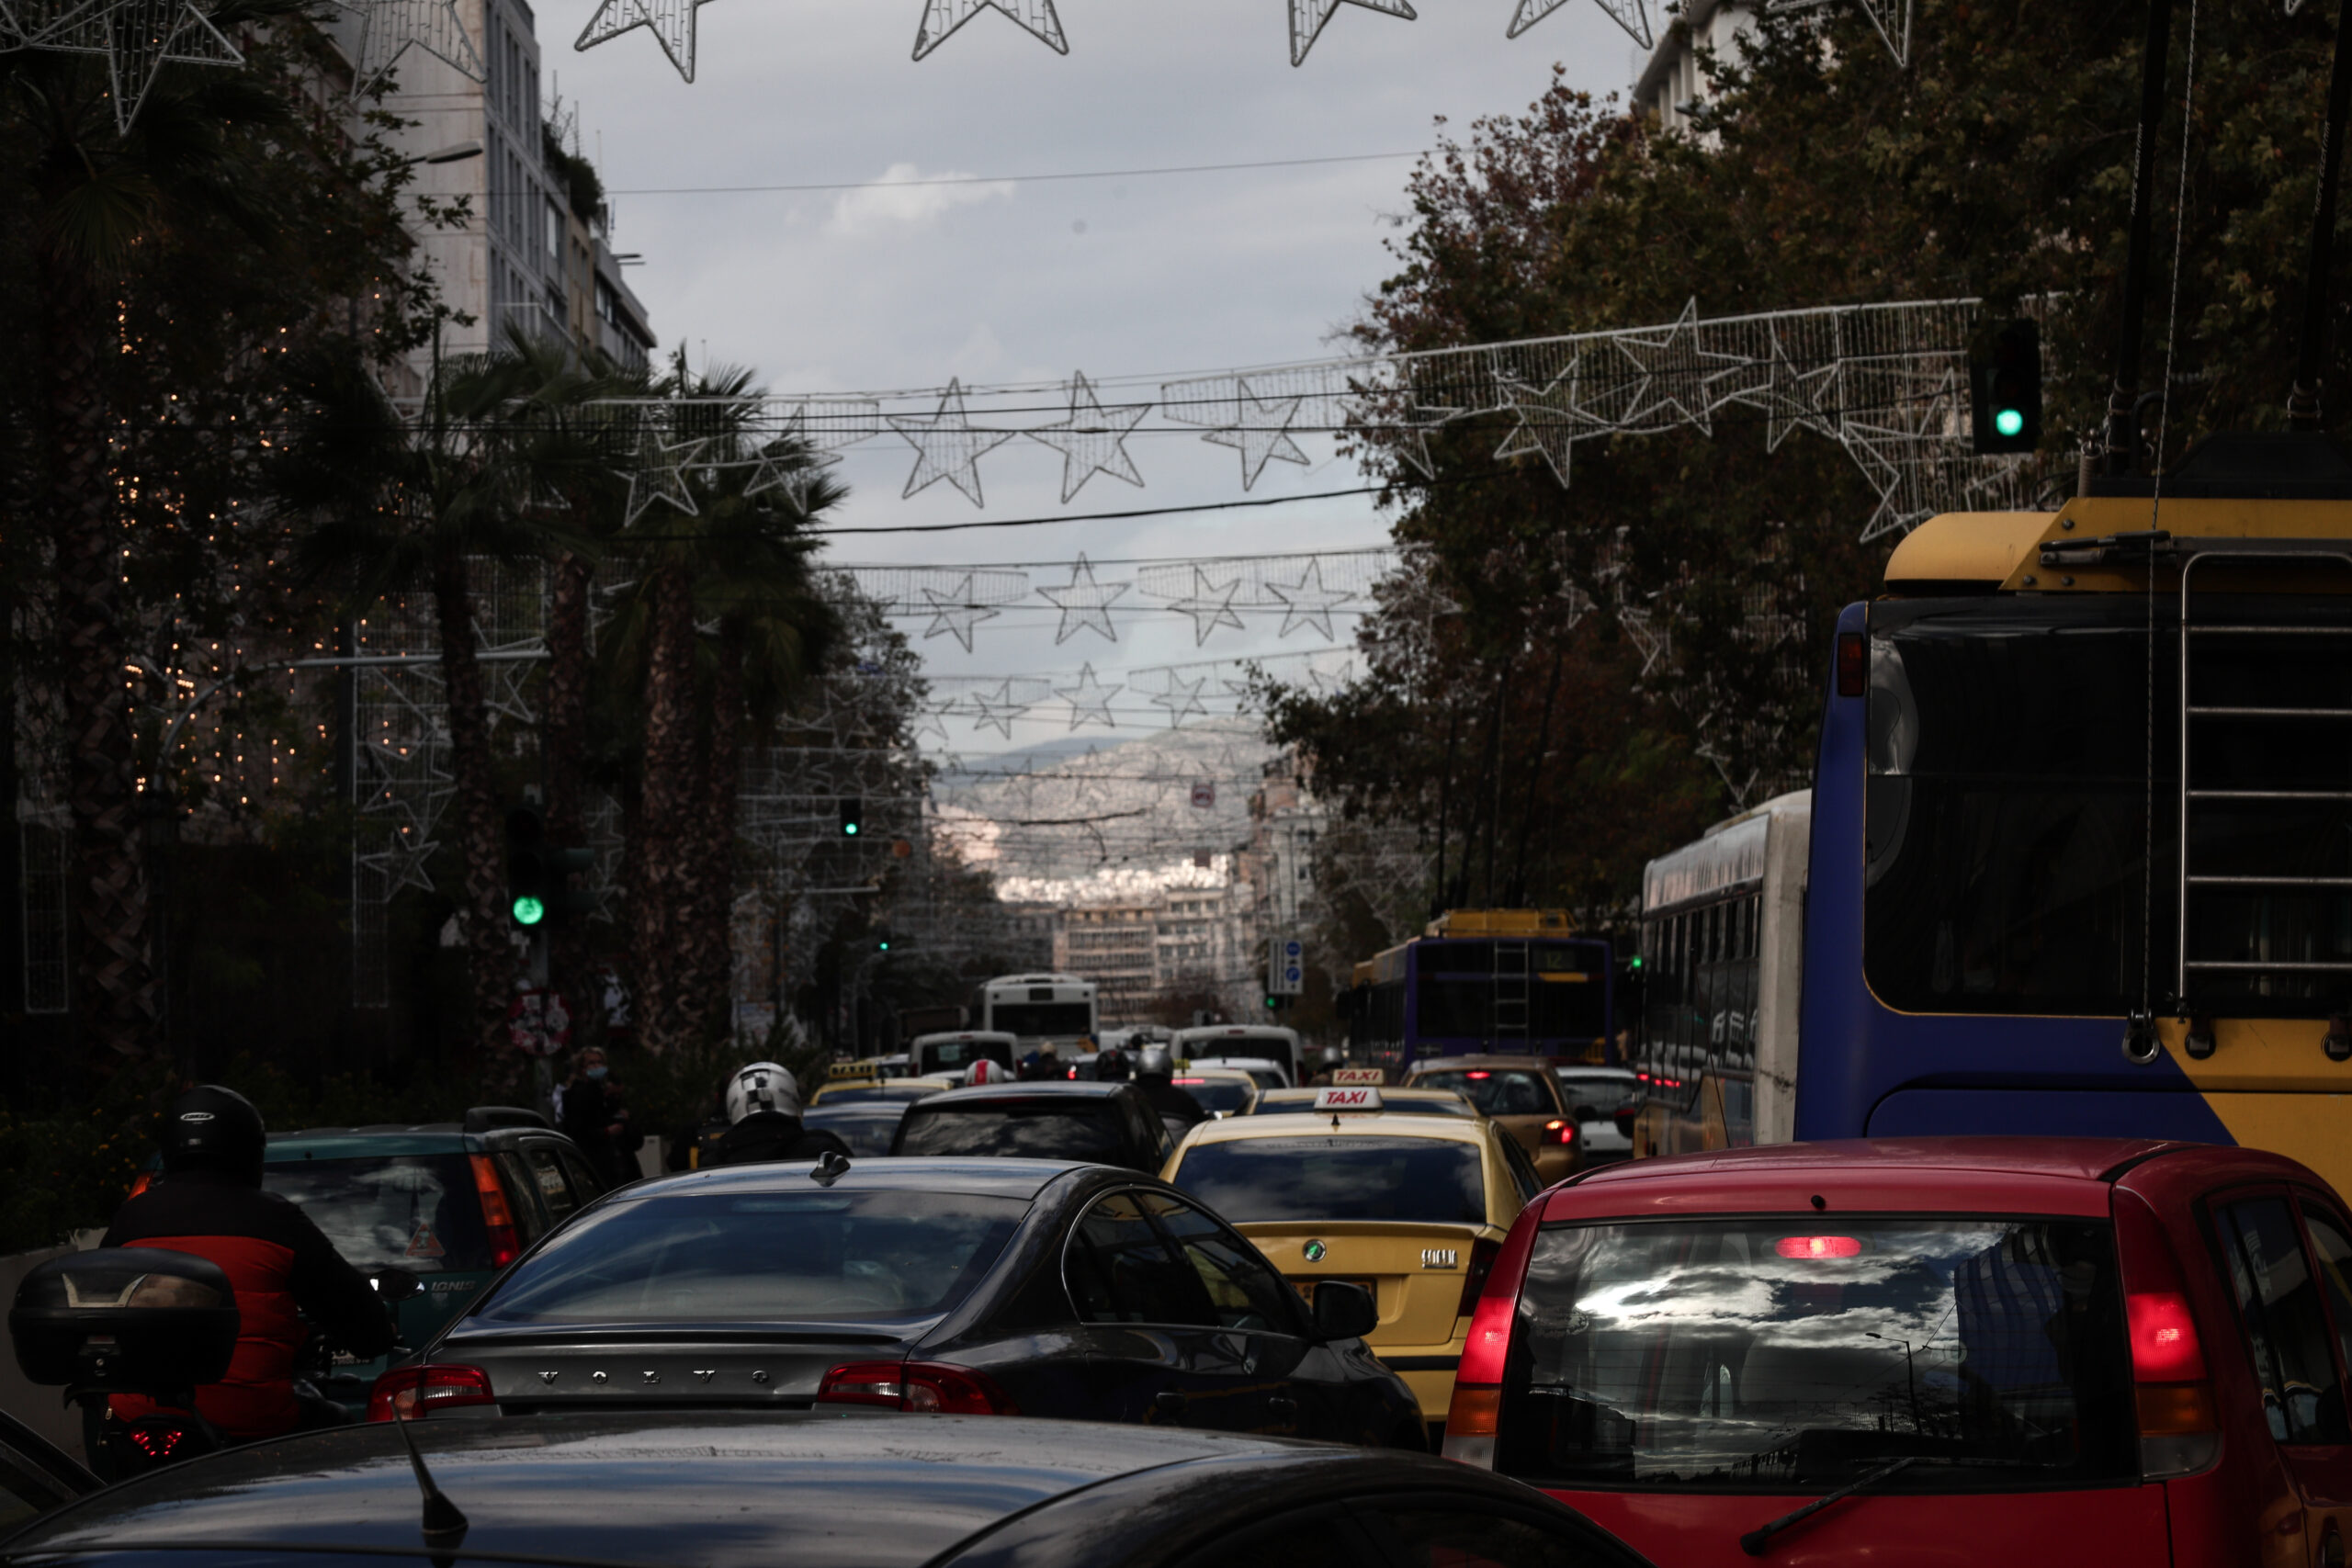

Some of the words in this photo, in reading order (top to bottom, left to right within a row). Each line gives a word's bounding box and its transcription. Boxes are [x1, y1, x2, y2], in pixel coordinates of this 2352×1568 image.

[1336, 1071, 1379, 1081] TAXI
[1327, 1091, 1367, 1104] TAXI
[431, 1280, 477, 1292] IGNIS
[537, 1371, 769, 1384] VOLVO
